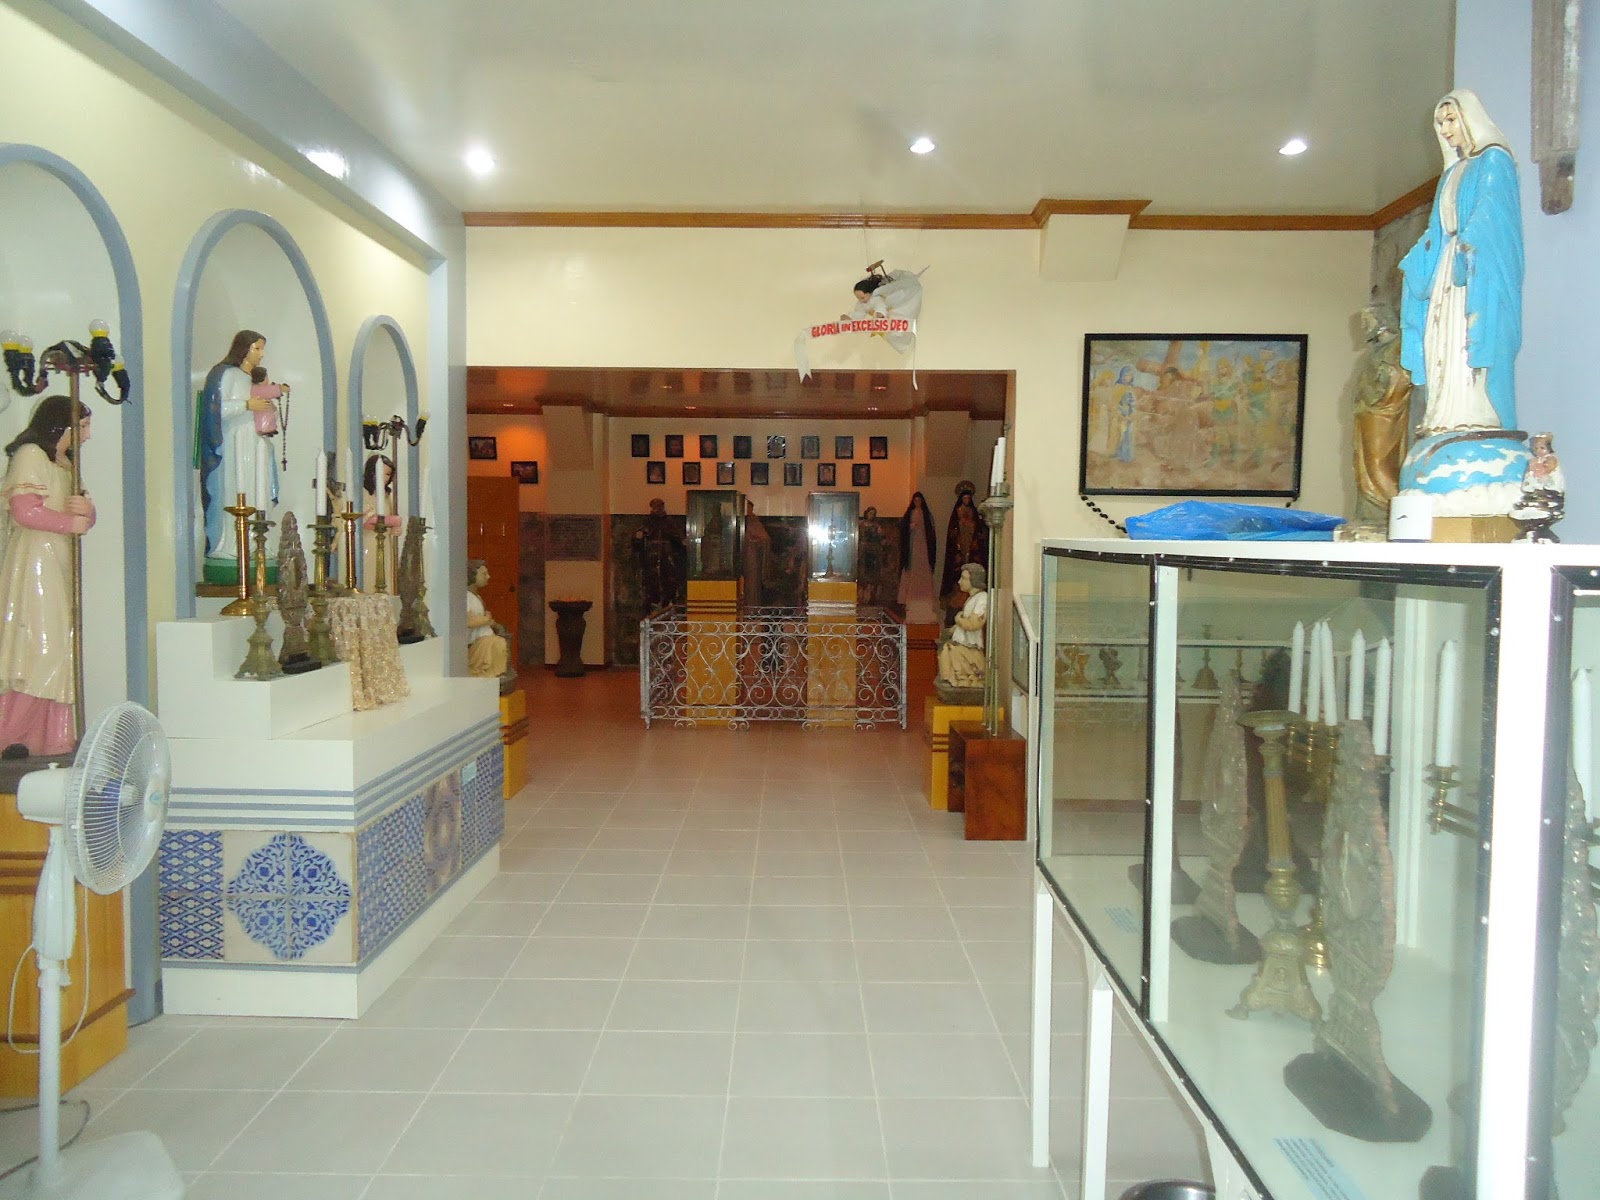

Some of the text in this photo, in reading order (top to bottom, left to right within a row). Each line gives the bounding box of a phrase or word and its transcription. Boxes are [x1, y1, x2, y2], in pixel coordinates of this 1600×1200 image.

[811, 319, 909, 338] GLORIA IN EXCELSIS DEO
